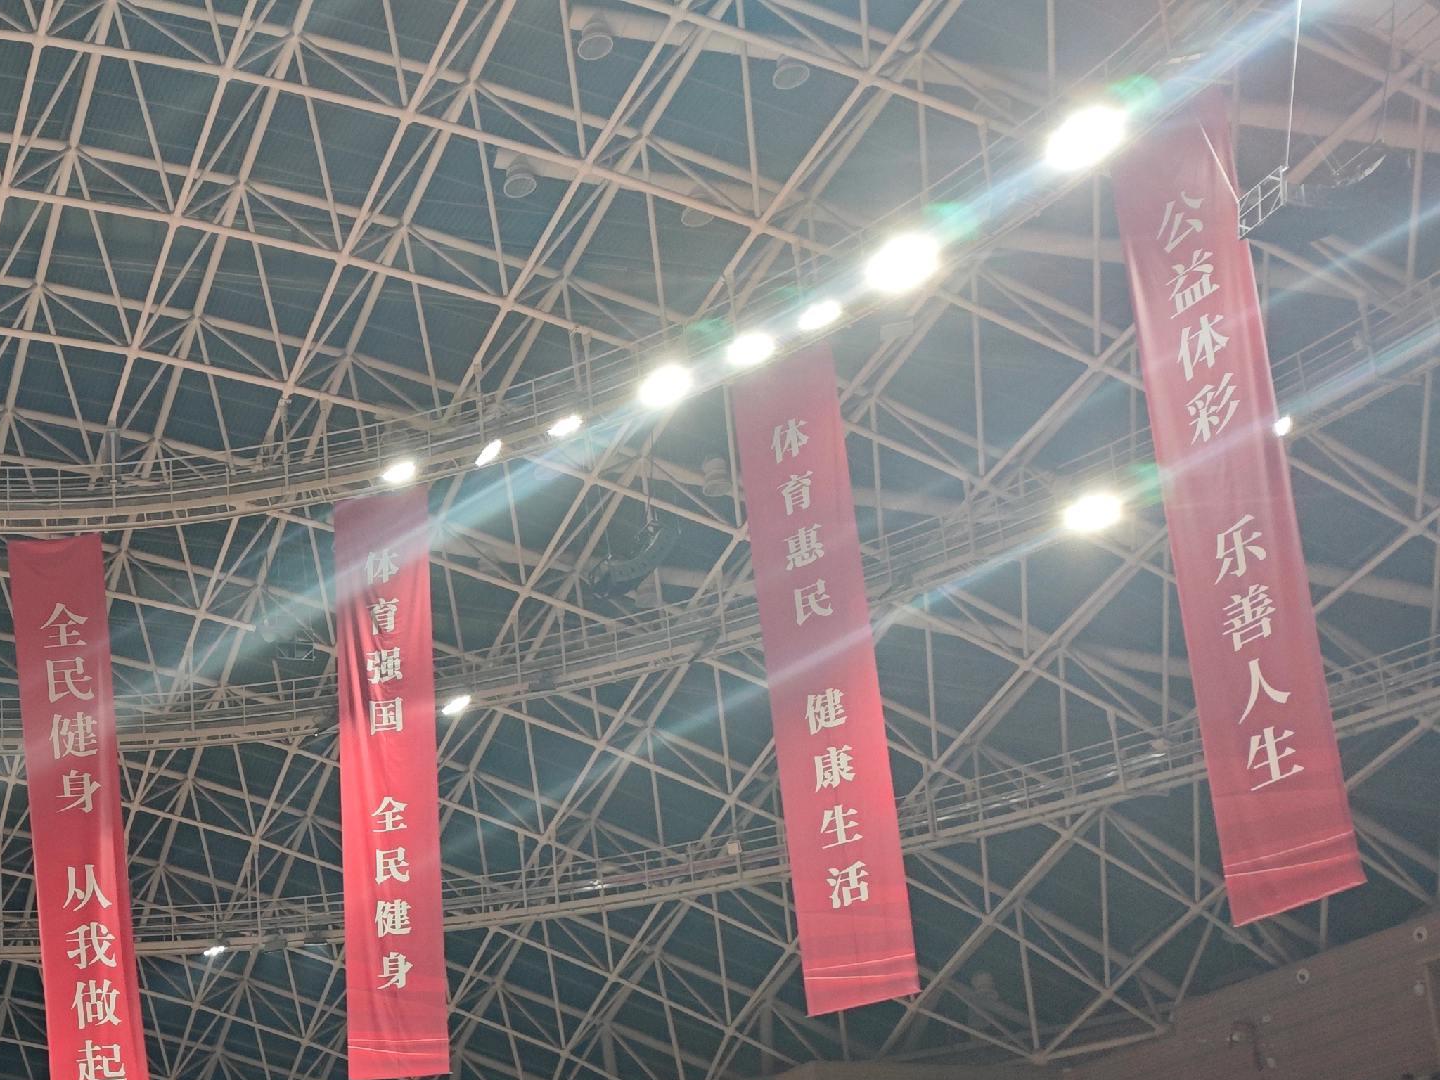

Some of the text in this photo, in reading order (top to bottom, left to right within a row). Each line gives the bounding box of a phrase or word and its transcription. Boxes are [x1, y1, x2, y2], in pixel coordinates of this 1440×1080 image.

[40, 602, 102, 814] 全民健身
[771, 417, 870, 910] 体育惠民 健康生活
[1156, 189, 1305, 793] 公益体彩 乐善人生
[364, 549, 414, 991] 体育强国 全民健身
